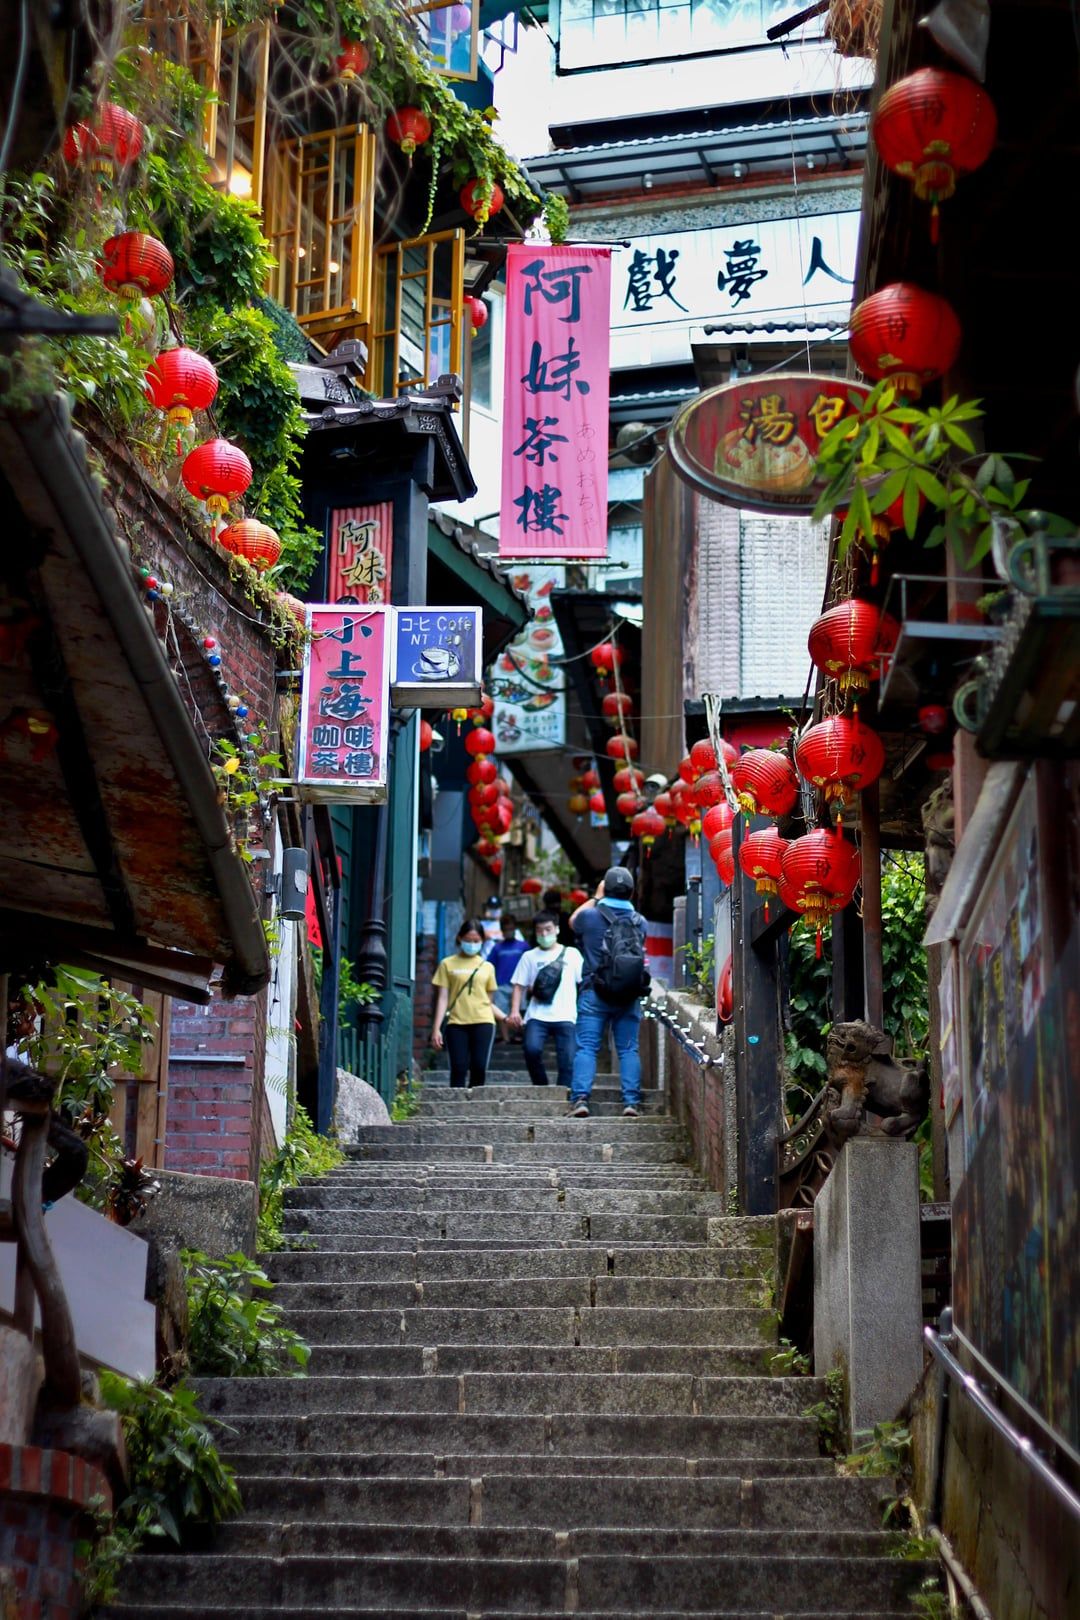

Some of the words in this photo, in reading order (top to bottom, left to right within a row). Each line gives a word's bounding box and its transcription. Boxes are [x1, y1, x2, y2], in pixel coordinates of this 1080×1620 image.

[623, 237, 855, 313] 戲夢人
[512, 258, 593, 536] 阿妹茶樓
[739, 394, 861, 446] 湯包
[338, 521, 385, 586] 阿妹
[410, 633, 429, 645] NT
[319, 616, 373, 721] 小上海
[311, 752, 374, 776] 茶樓
[312, 724, 374, 749] 咖啡
